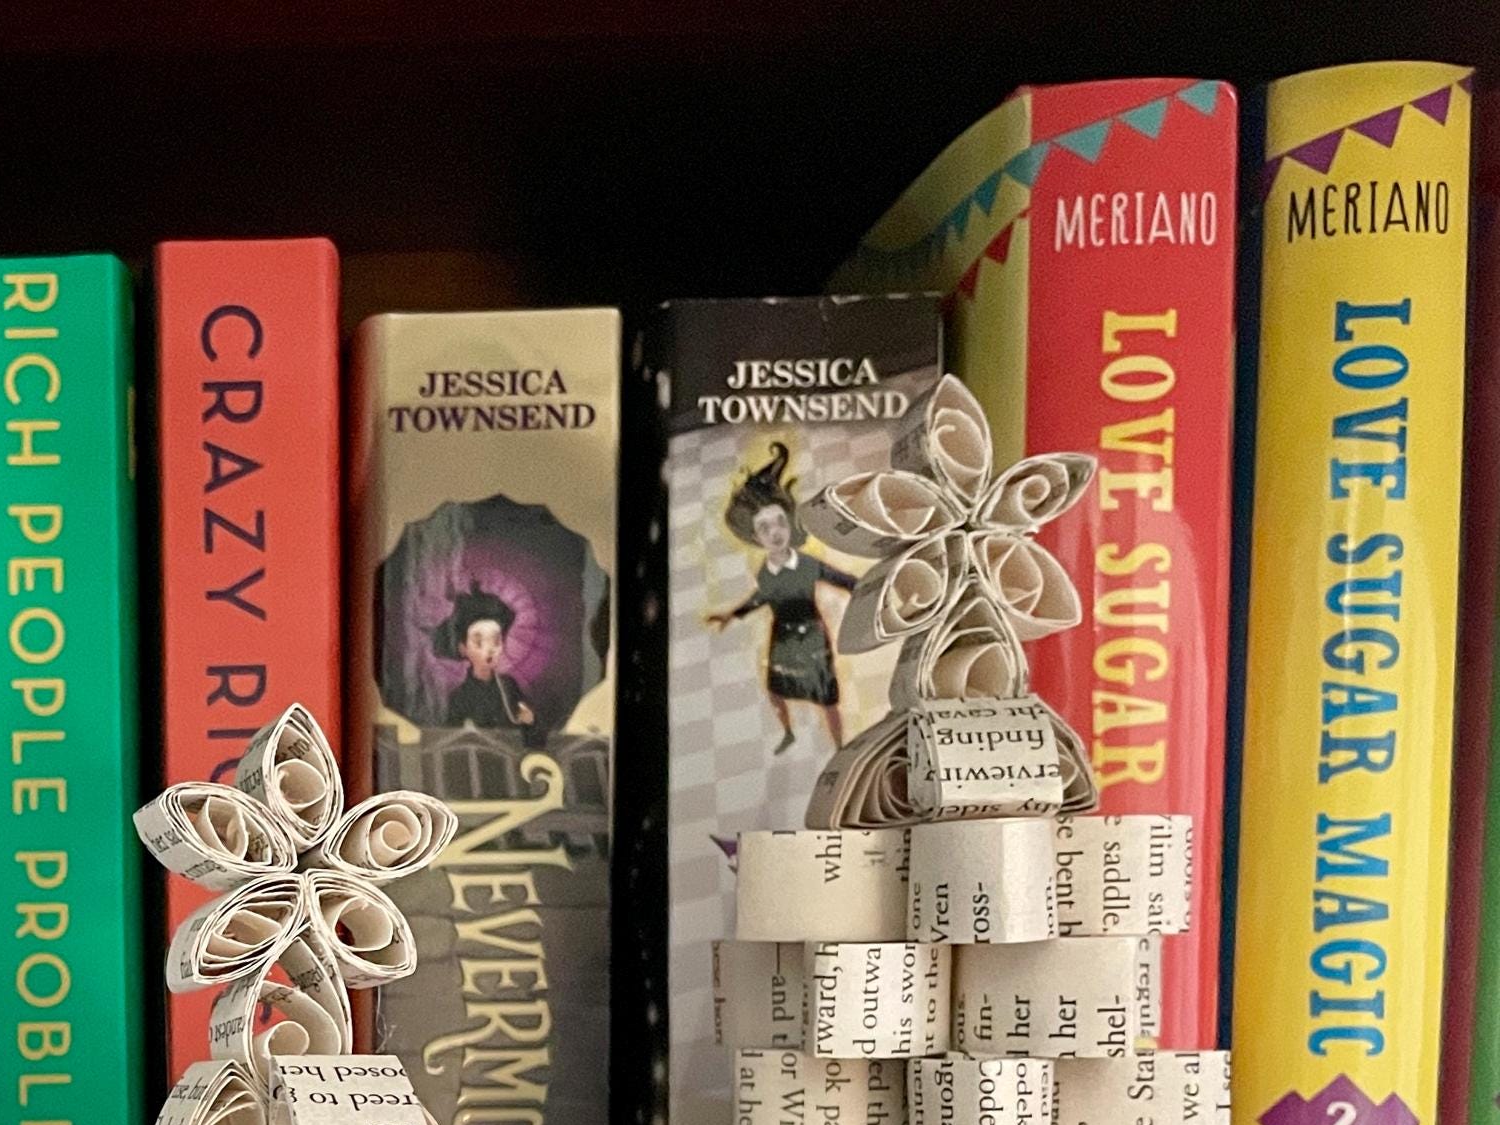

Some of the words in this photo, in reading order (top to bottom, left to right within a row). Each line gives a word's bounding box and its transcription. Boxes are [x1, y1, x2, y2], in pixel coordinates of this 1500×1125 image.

[1055, 192, 1217, 251] MERIANO
[1288, 181, 1448, 243] MERIANO
[3, 273, 61, 466] RICH
[419, 369, 567, 398] JESSICA
[699, 392, 910, 423] TOWNSEND
[727, 359, 879, 389] JESSICA
[1330, 298, 1411, 499] LOVE
[389, 405, 595, 432] TOWNSEND
[1101, 309, 1178, 512] LOVE
[201, 304, 268, 621] CRAZY
[8, 505, 67, 814] PEOPLE
[1091, 543, 1172, 788] SUGAR
[1319, 534, 1404, 784] SUGAR
[1103, 843, 1132, 932] saddle,
[1307, 812, 1393, 1056] MAGIC
[973, 992, 996, 1042] fin-
[1049, 994, 1079, 1043] her
[1097, 993, 1127, 1059] shel-
